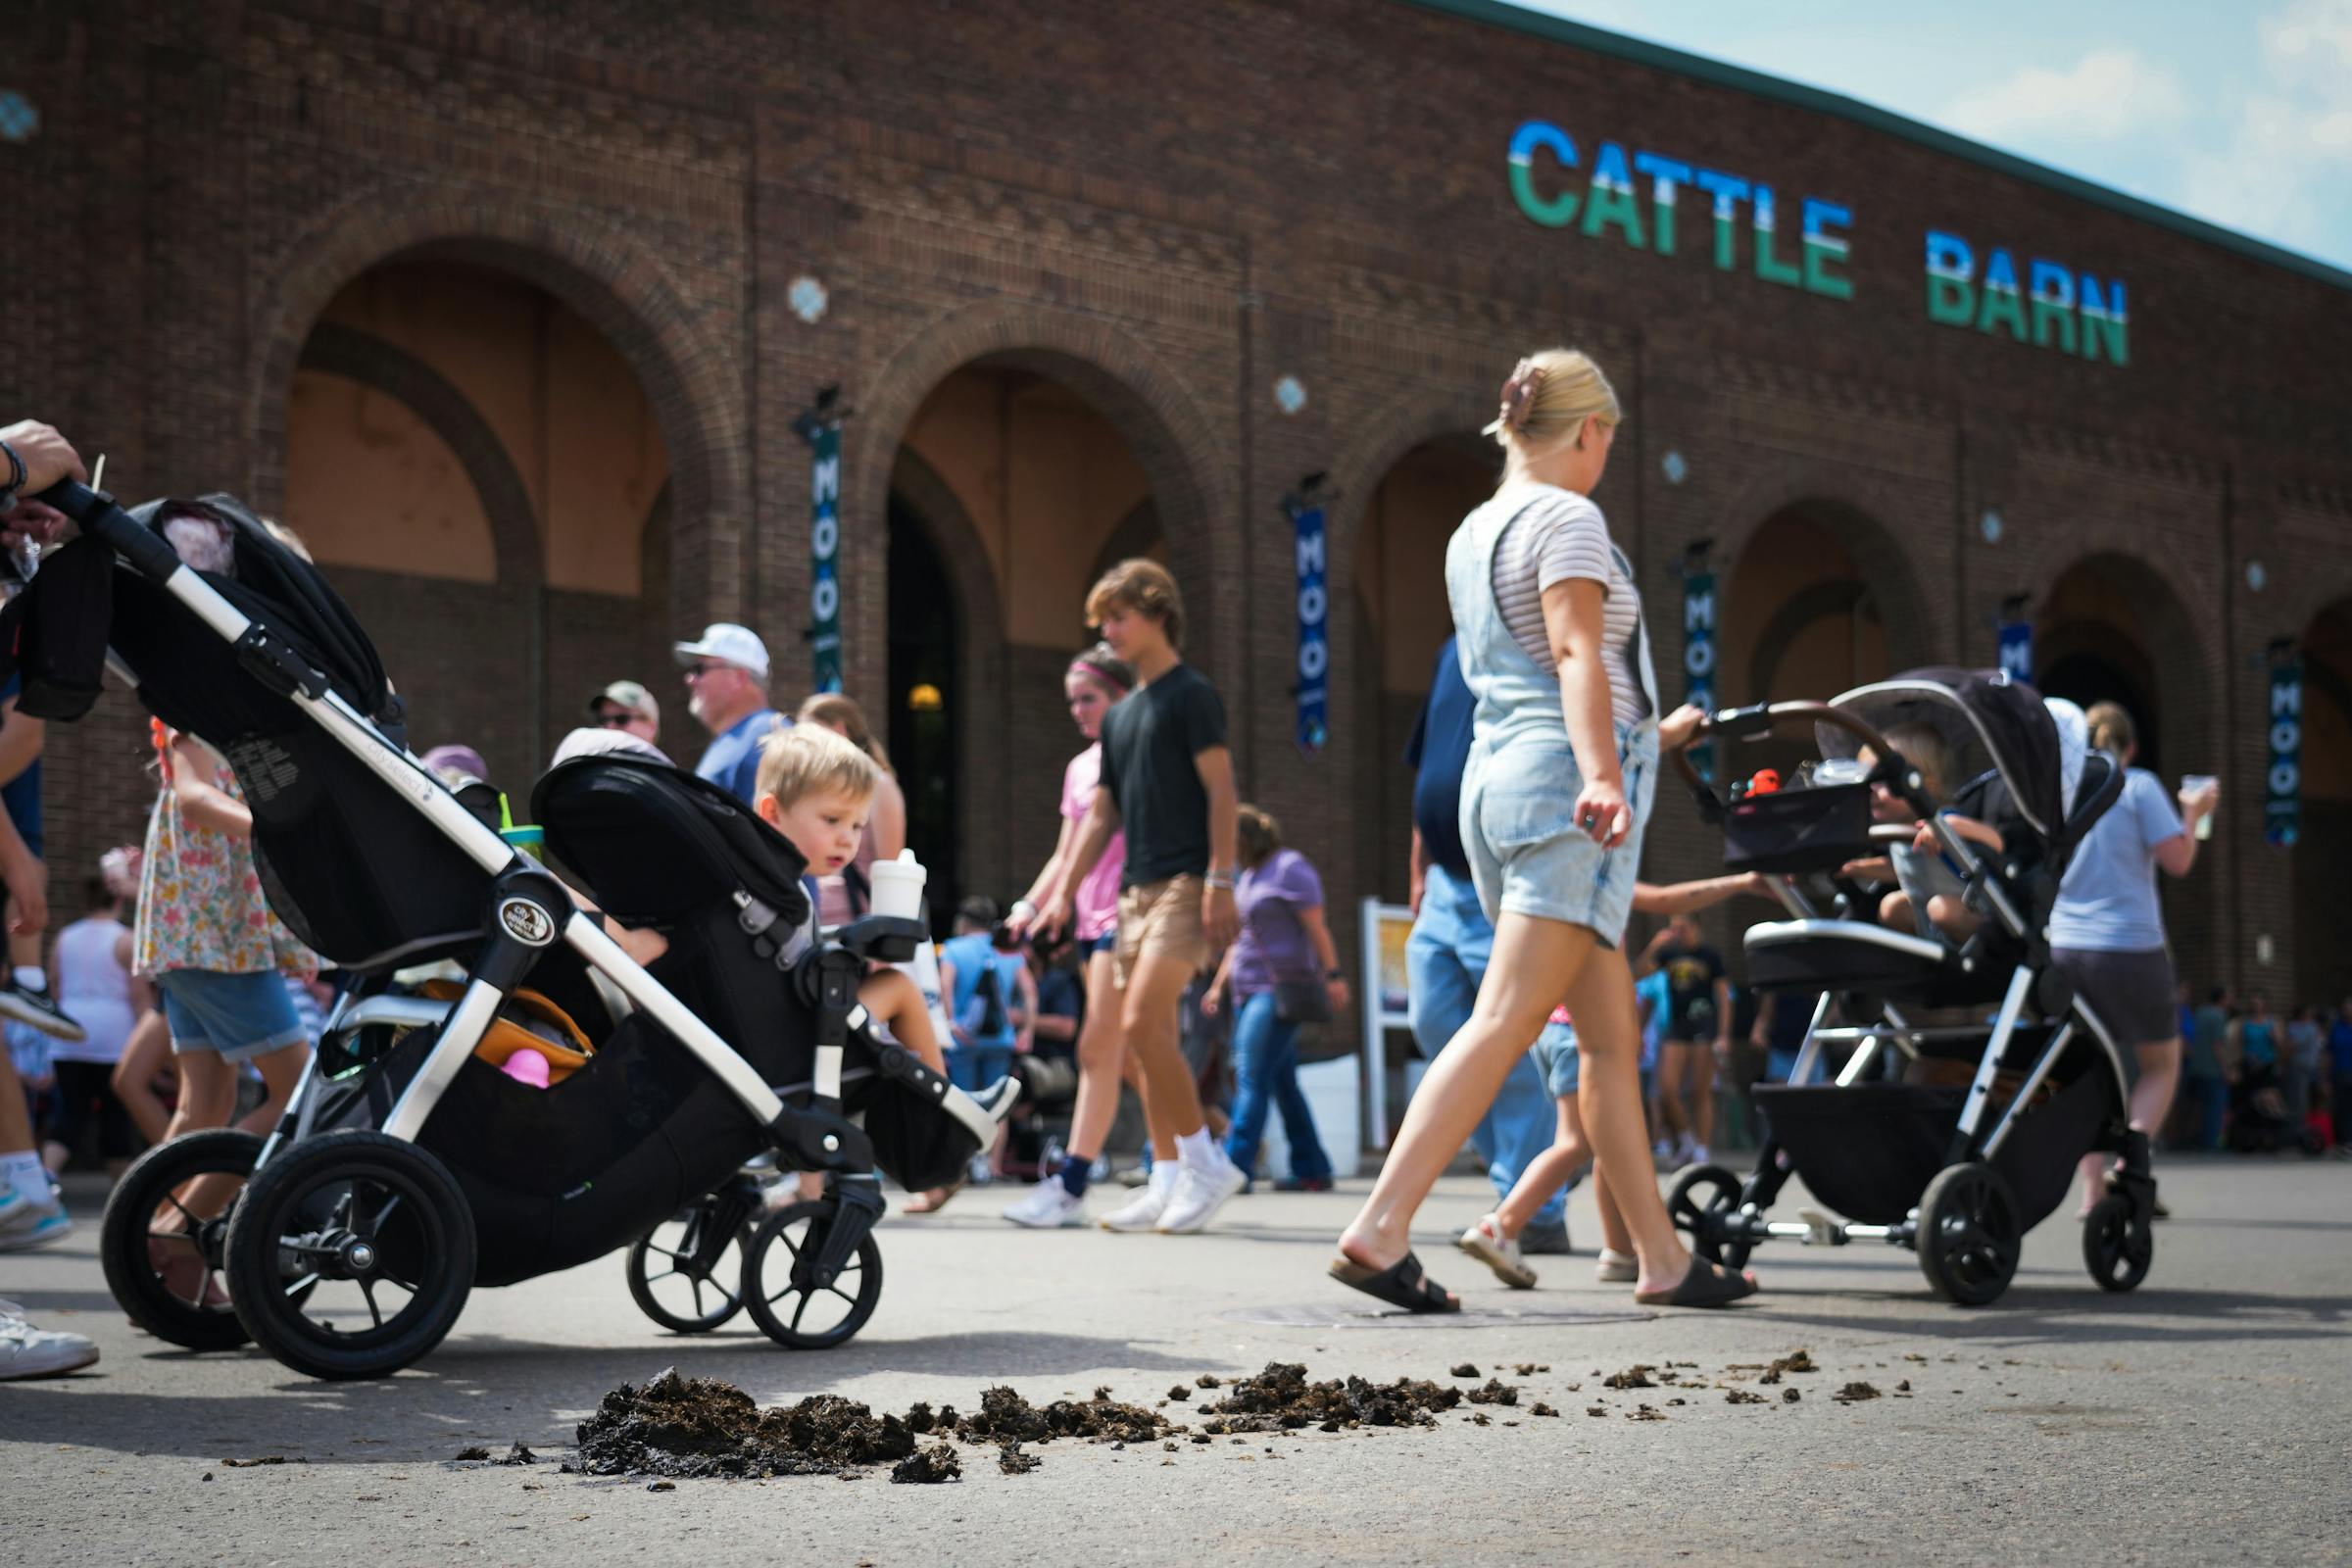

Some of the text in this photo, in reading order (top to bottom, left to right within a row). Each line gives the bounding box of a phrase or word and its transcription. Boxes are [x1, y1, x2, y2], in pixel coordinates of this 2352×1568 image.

[1508, 119, 2129, 367] CATTLE BARN
[811, 455, 839, 622] MOO
[1297, 530, 1327, 680] MOO
[2269, 681, 2301, 796] MOO
